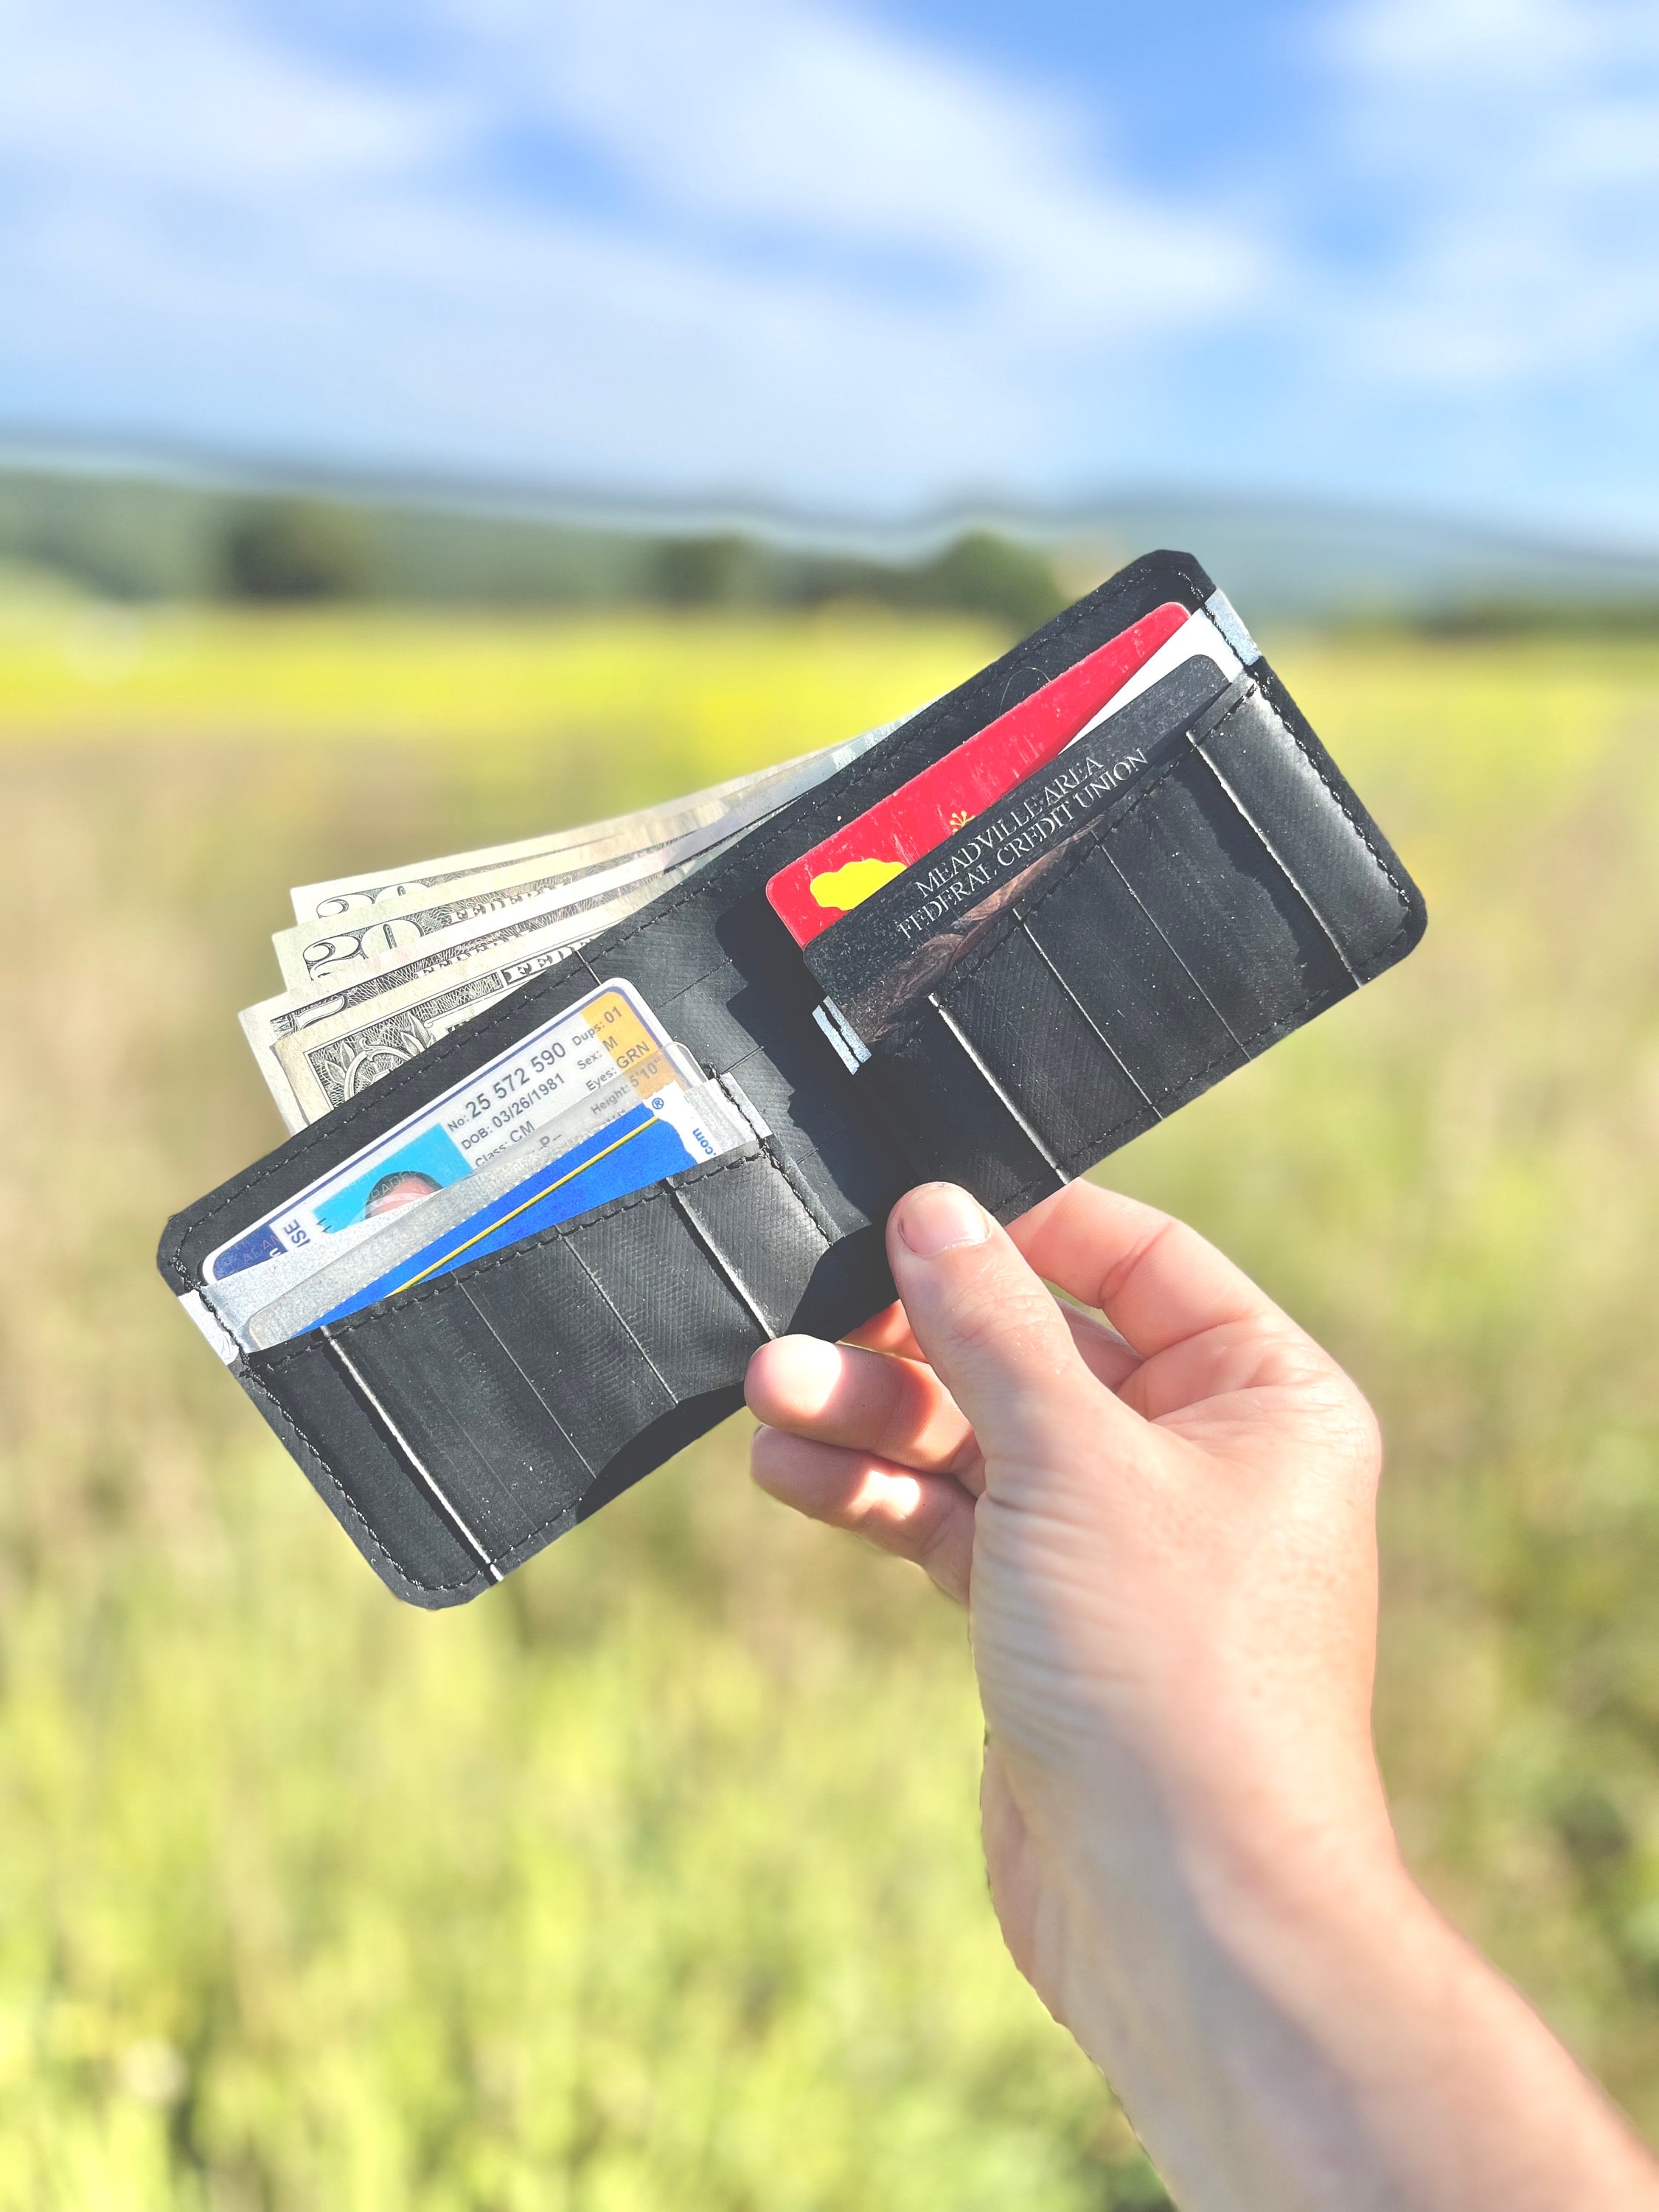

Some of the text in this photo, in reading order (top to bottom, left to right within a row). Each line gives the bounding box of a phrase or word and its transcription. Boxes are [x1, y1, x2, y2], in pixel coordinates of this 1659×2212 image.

[896, 747, 1150, 940] FEDERAL CREDIT UNION
[915, 757, 1105, 898] MEADVILLE AREA
[571, 1005, 623, 1046] Dups: 01
[577, 1035, 619, 1070] Sex: M
[585, 1040, 650, 1092] Eyes: GRN
[447, 1041, 567, 1133] No: 25 572 590
[461, 1126, 494, 1150] DOB:
[491, 1072, 566, 1130] 03/26/1981
[591, 1084, 632, 1116] Height:
[475, 1120, 537, 1168] Class: CM
[692, 1127, 717, 1156] .com
